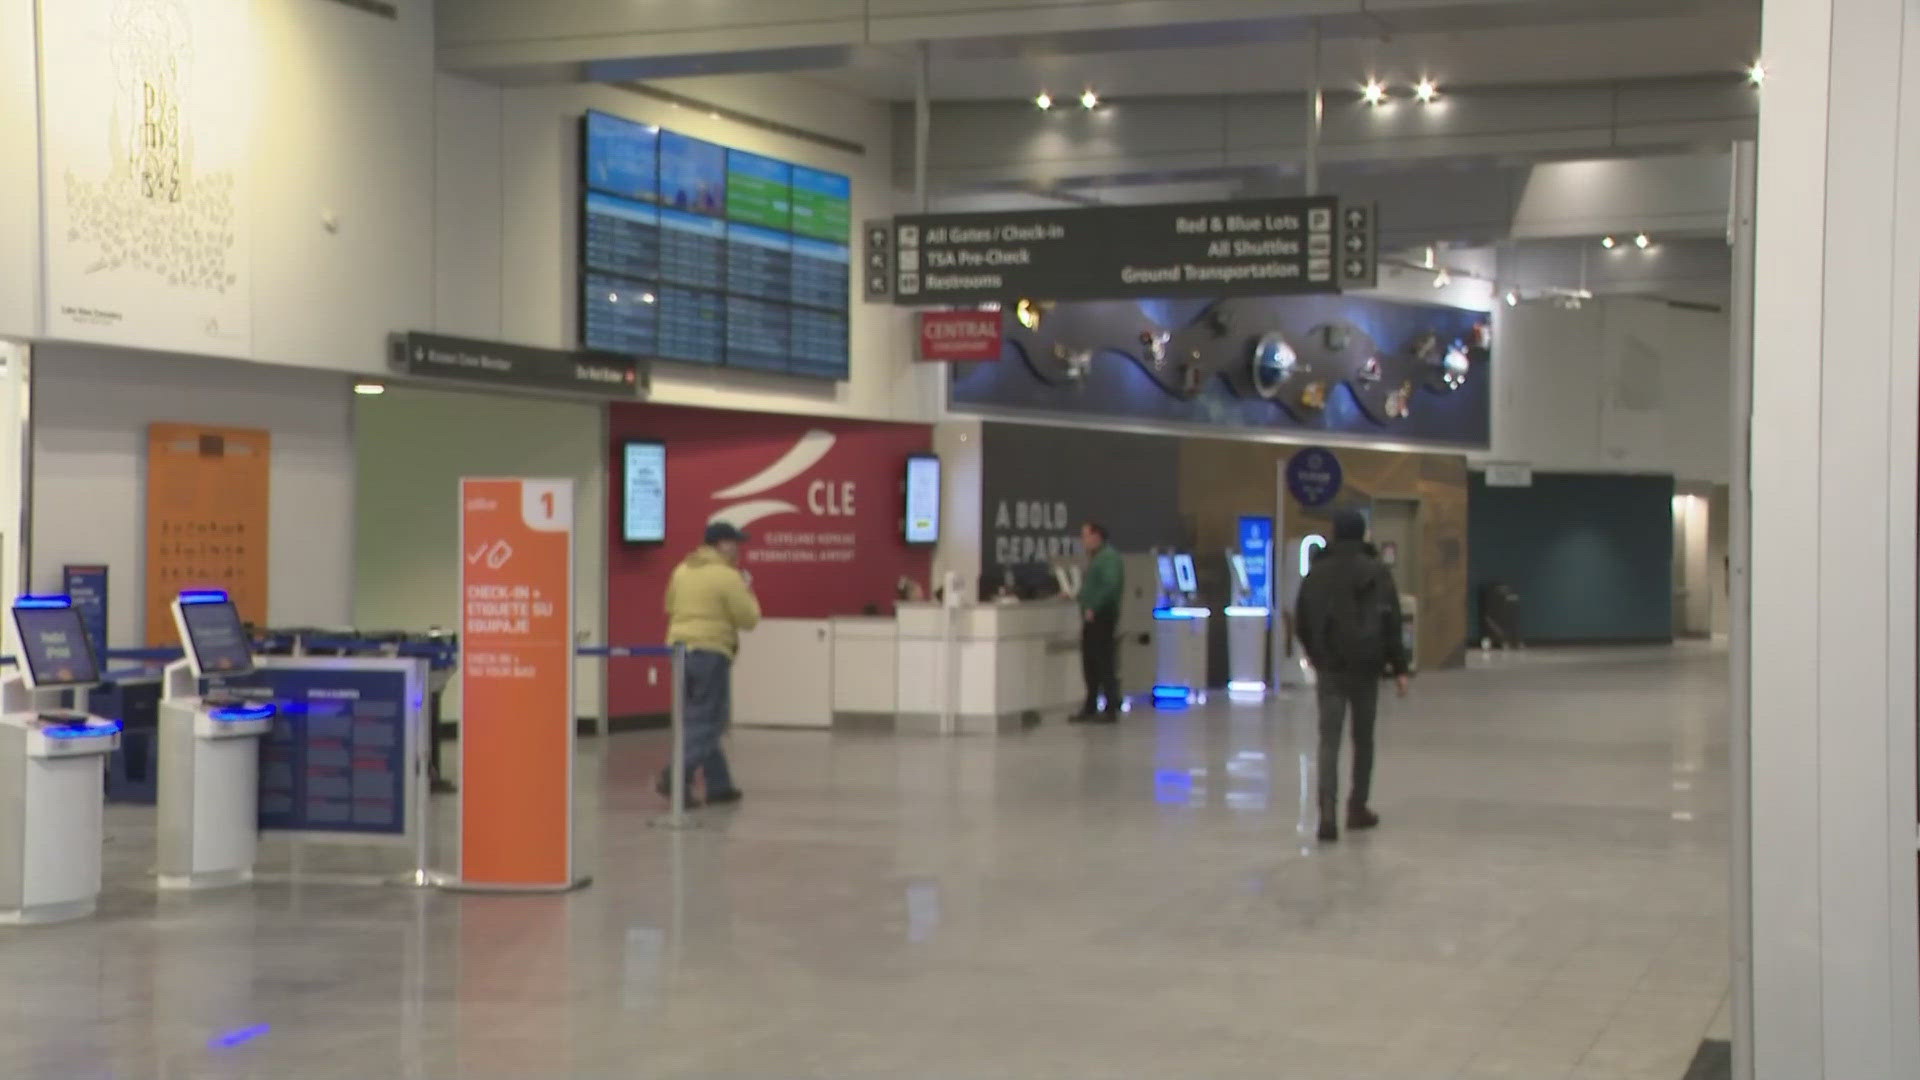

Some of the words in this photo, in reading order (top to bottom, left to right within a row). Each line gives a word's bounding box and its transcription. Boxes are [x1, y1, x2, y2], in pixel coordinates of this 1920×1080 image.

[1176, 216, 1207, 234] Red
[1209, 216, 1223, 232] &
[1226, 214, 1262, 232] Blue
[1265, 214, 1299, 231] Lots
[926, 226, 947, 244] All
[950, 227, 992, 243] Gates
[1207, 239, 1231, 257] All
[1233, 238, 1299, 256] Shuttles
[928, 251, 956, 267] TSA
[925, 274, 1003, 290] Restrooms
[1121, 264, 1181, 284] Ground
[1183, 261, 1300, 284] Transportation
[924, 320, 998, 339] CENTRAL
[540, 491, 554, 520] 1
[807, 479, 856, 516] CLE
[995, 500, 1011, 530] A
[1015, 500, 1068, 531] BOLD
